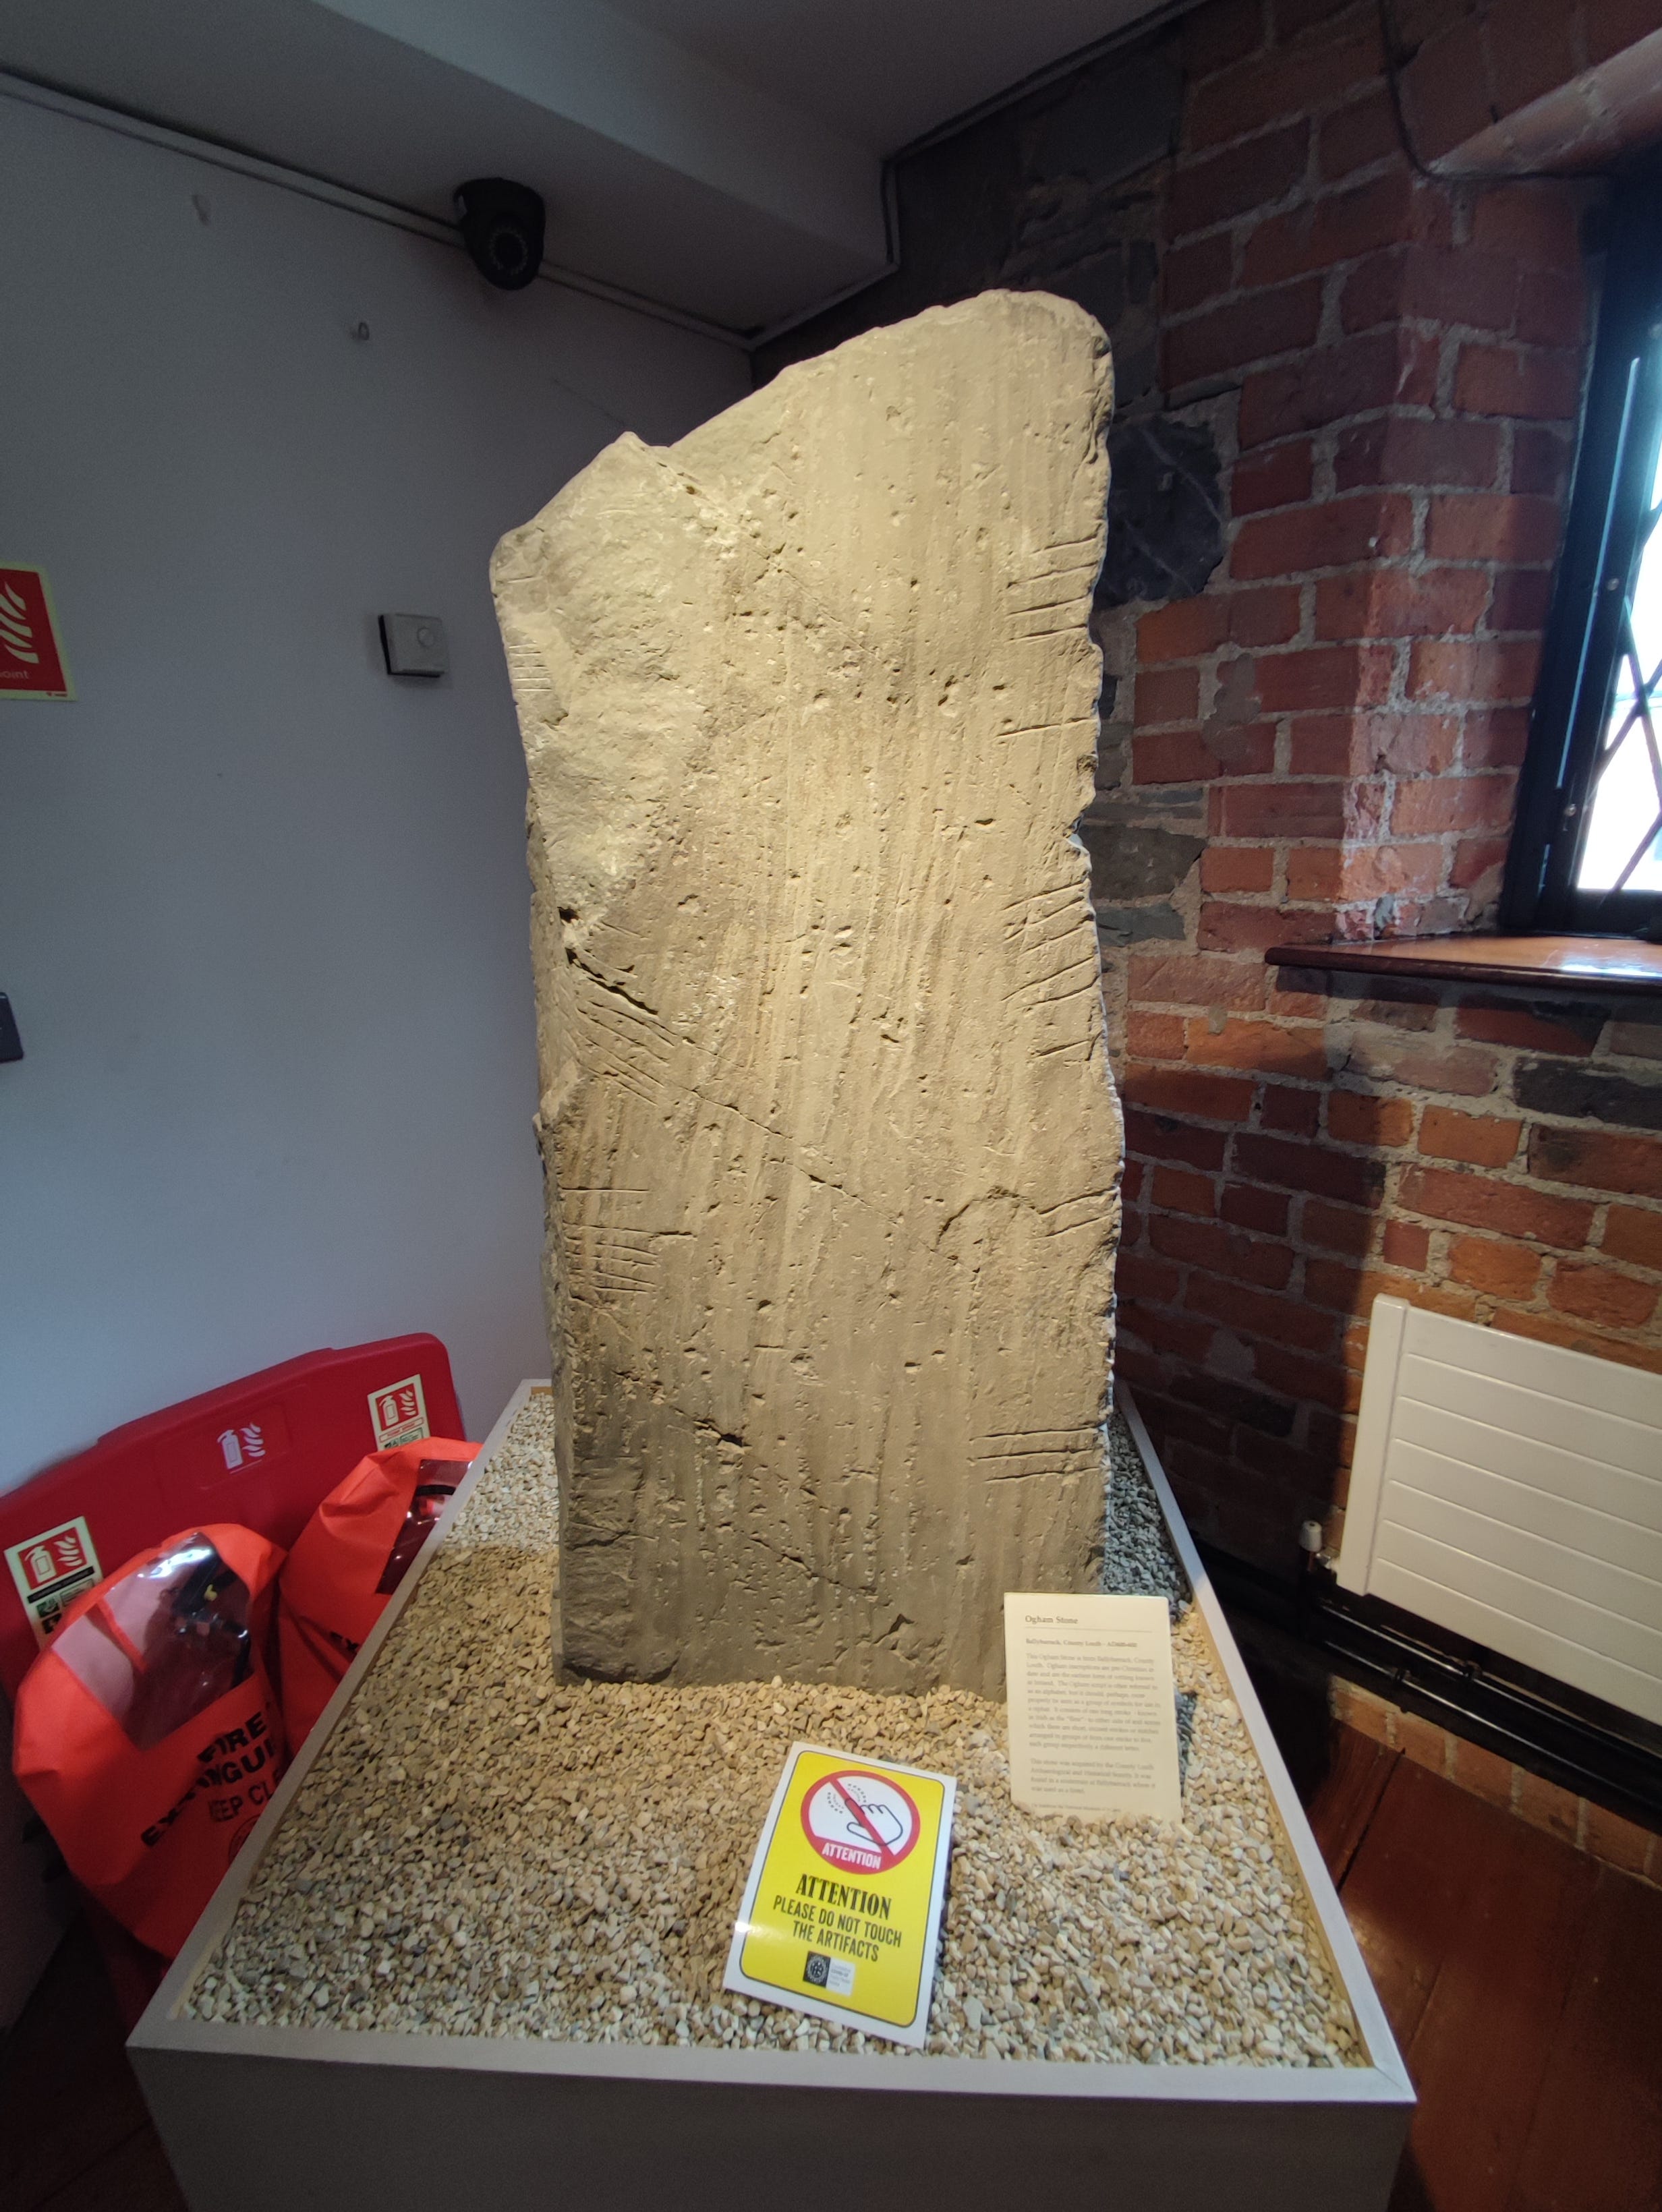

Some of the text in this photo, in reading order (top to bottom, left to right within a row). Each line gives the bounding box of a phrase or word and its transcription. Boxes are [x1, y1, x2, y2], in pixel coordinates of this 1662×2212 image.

[1025, 1615, 1079, 1625] Ogham Stone
[822, 1842, 882, 1870] ATTENTION
[795, 1873, 892, 1921] ATTENTION
[773, 1895, 902, 1948] PLEASE DO NOT TOUCH
[793, 1920, 880, 1962] THE ARTIFACTS
